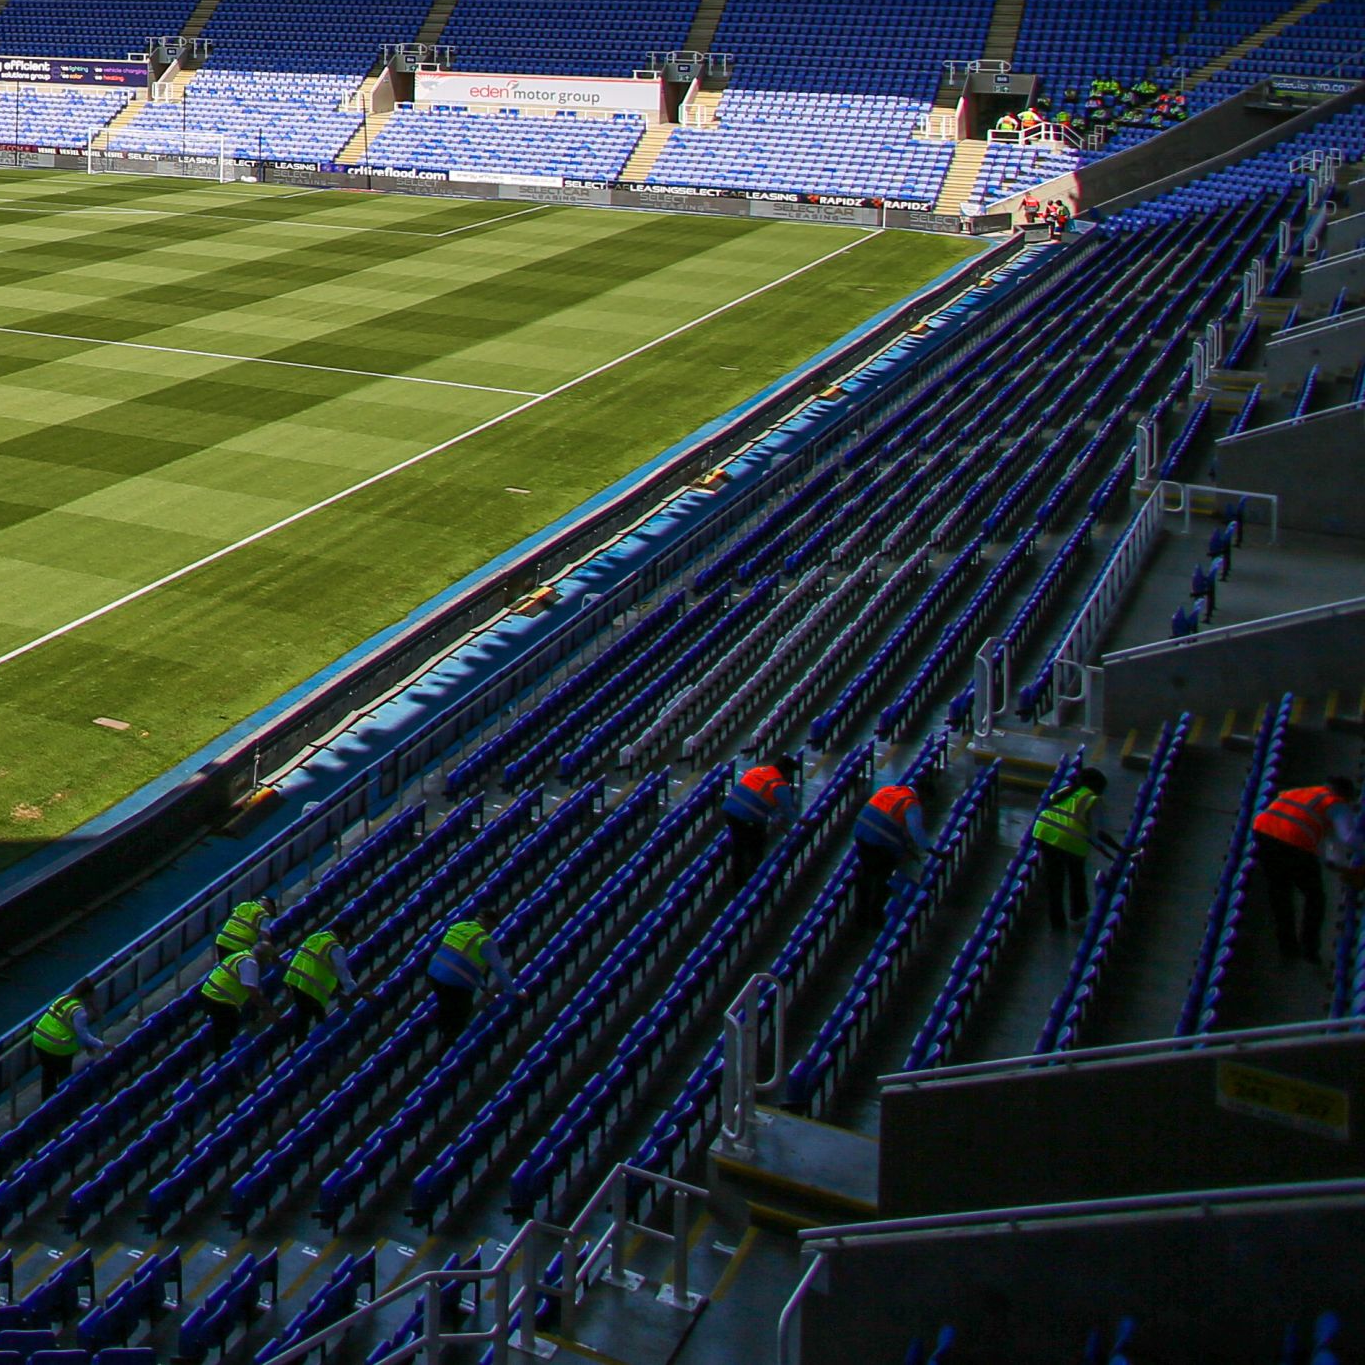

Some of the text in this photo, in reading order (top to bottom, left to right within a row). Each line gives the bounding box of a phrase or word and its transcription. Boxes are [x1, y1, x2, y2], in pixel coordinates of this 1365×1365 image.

[3, 58, 51, 71] efficient
[1, 71, 30, 79] solutions
[30, 72, 52, 81] group
[469, 84, 601, 105] eden motor group
[396, 178, 438, 187] SELECT
[639, 193, 688, 203] SELECT
[819, 195, 863, 207] RAPIDZ
[772, 202, 855, 217] SELECT CAR
[884, 200, 929, 211] RAPIDZ
[788, 212, 840, 221] LEASING
[909, 213, 960, 226] SELECT
